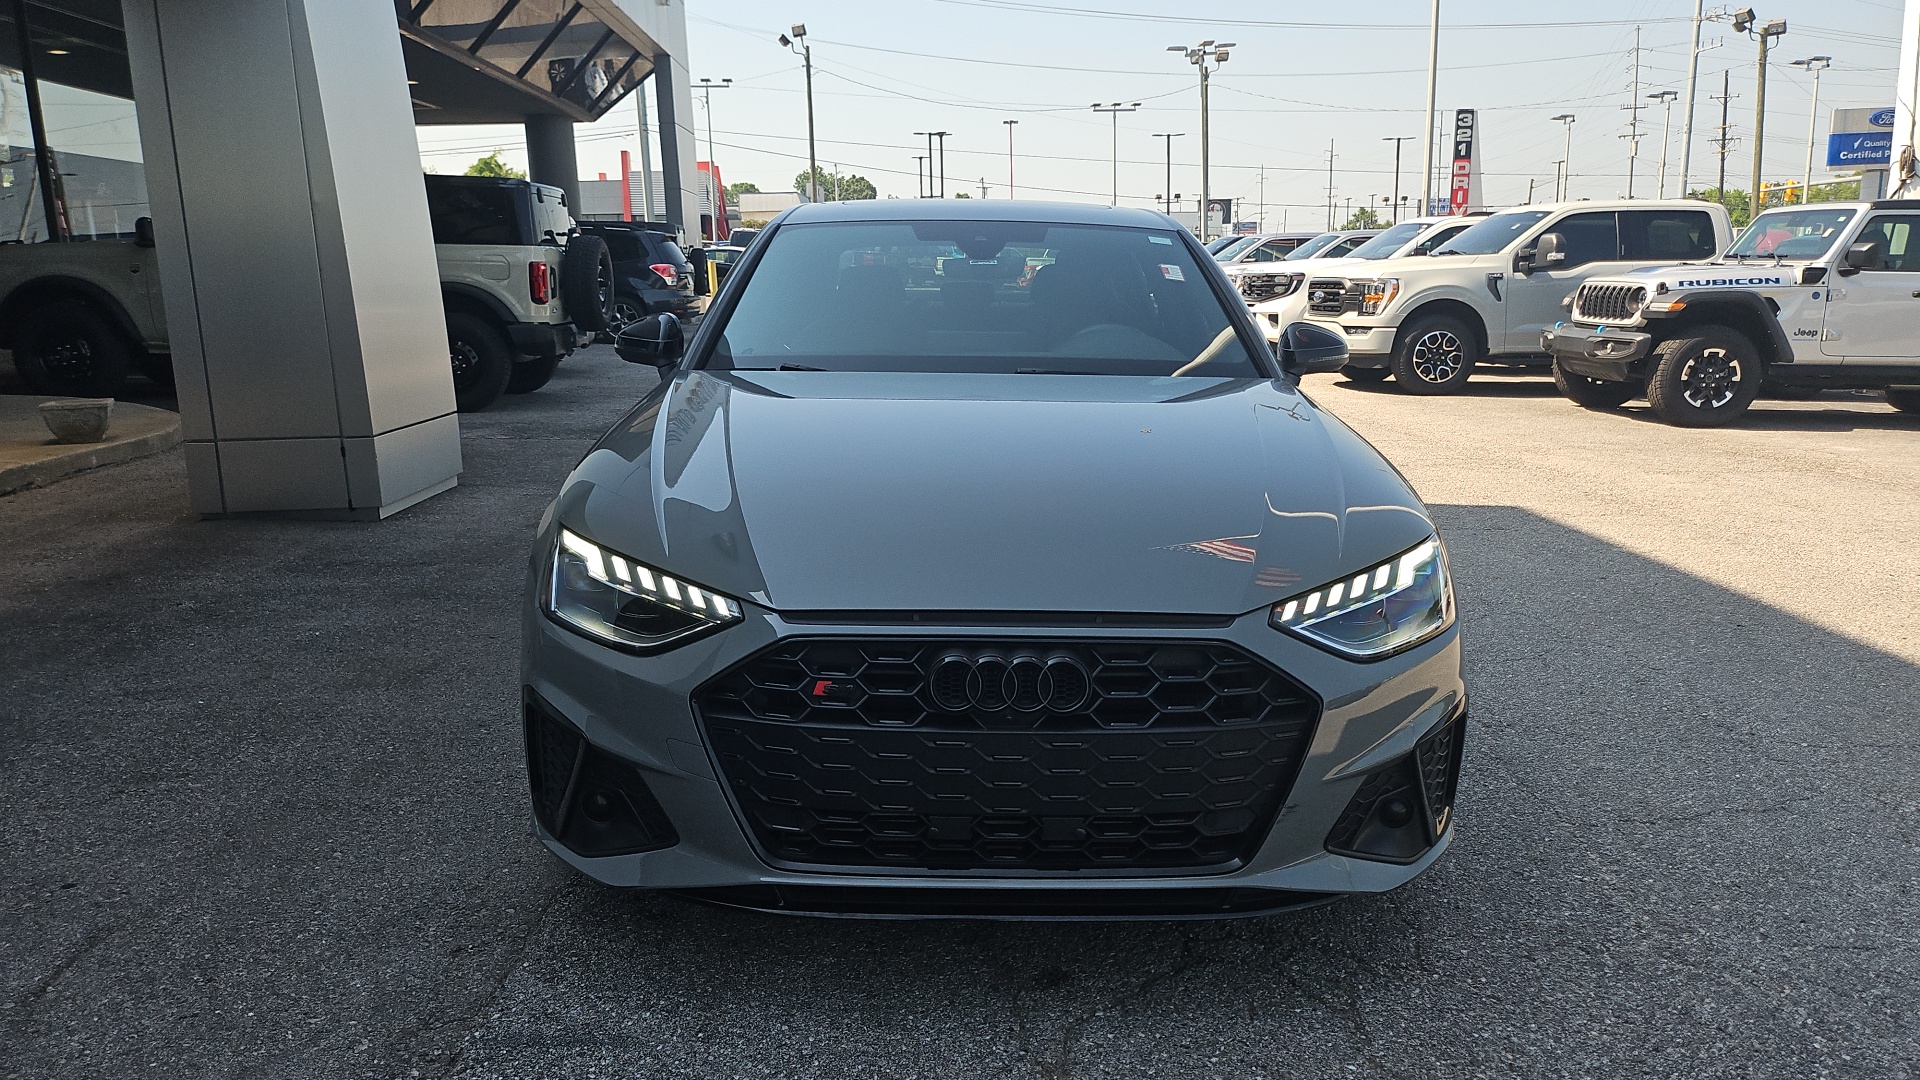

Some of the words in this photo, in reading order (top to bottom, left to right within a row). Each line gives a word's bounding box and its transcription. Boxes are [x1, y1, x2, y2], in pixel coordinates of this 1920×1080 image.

[1864, 140, 1891, 148] Quality
[1840, 150, 1882, 159] Certified
[1678, 277, 1781, 287] RUBICON
[1793, 327, 1818, 338] Jeep
